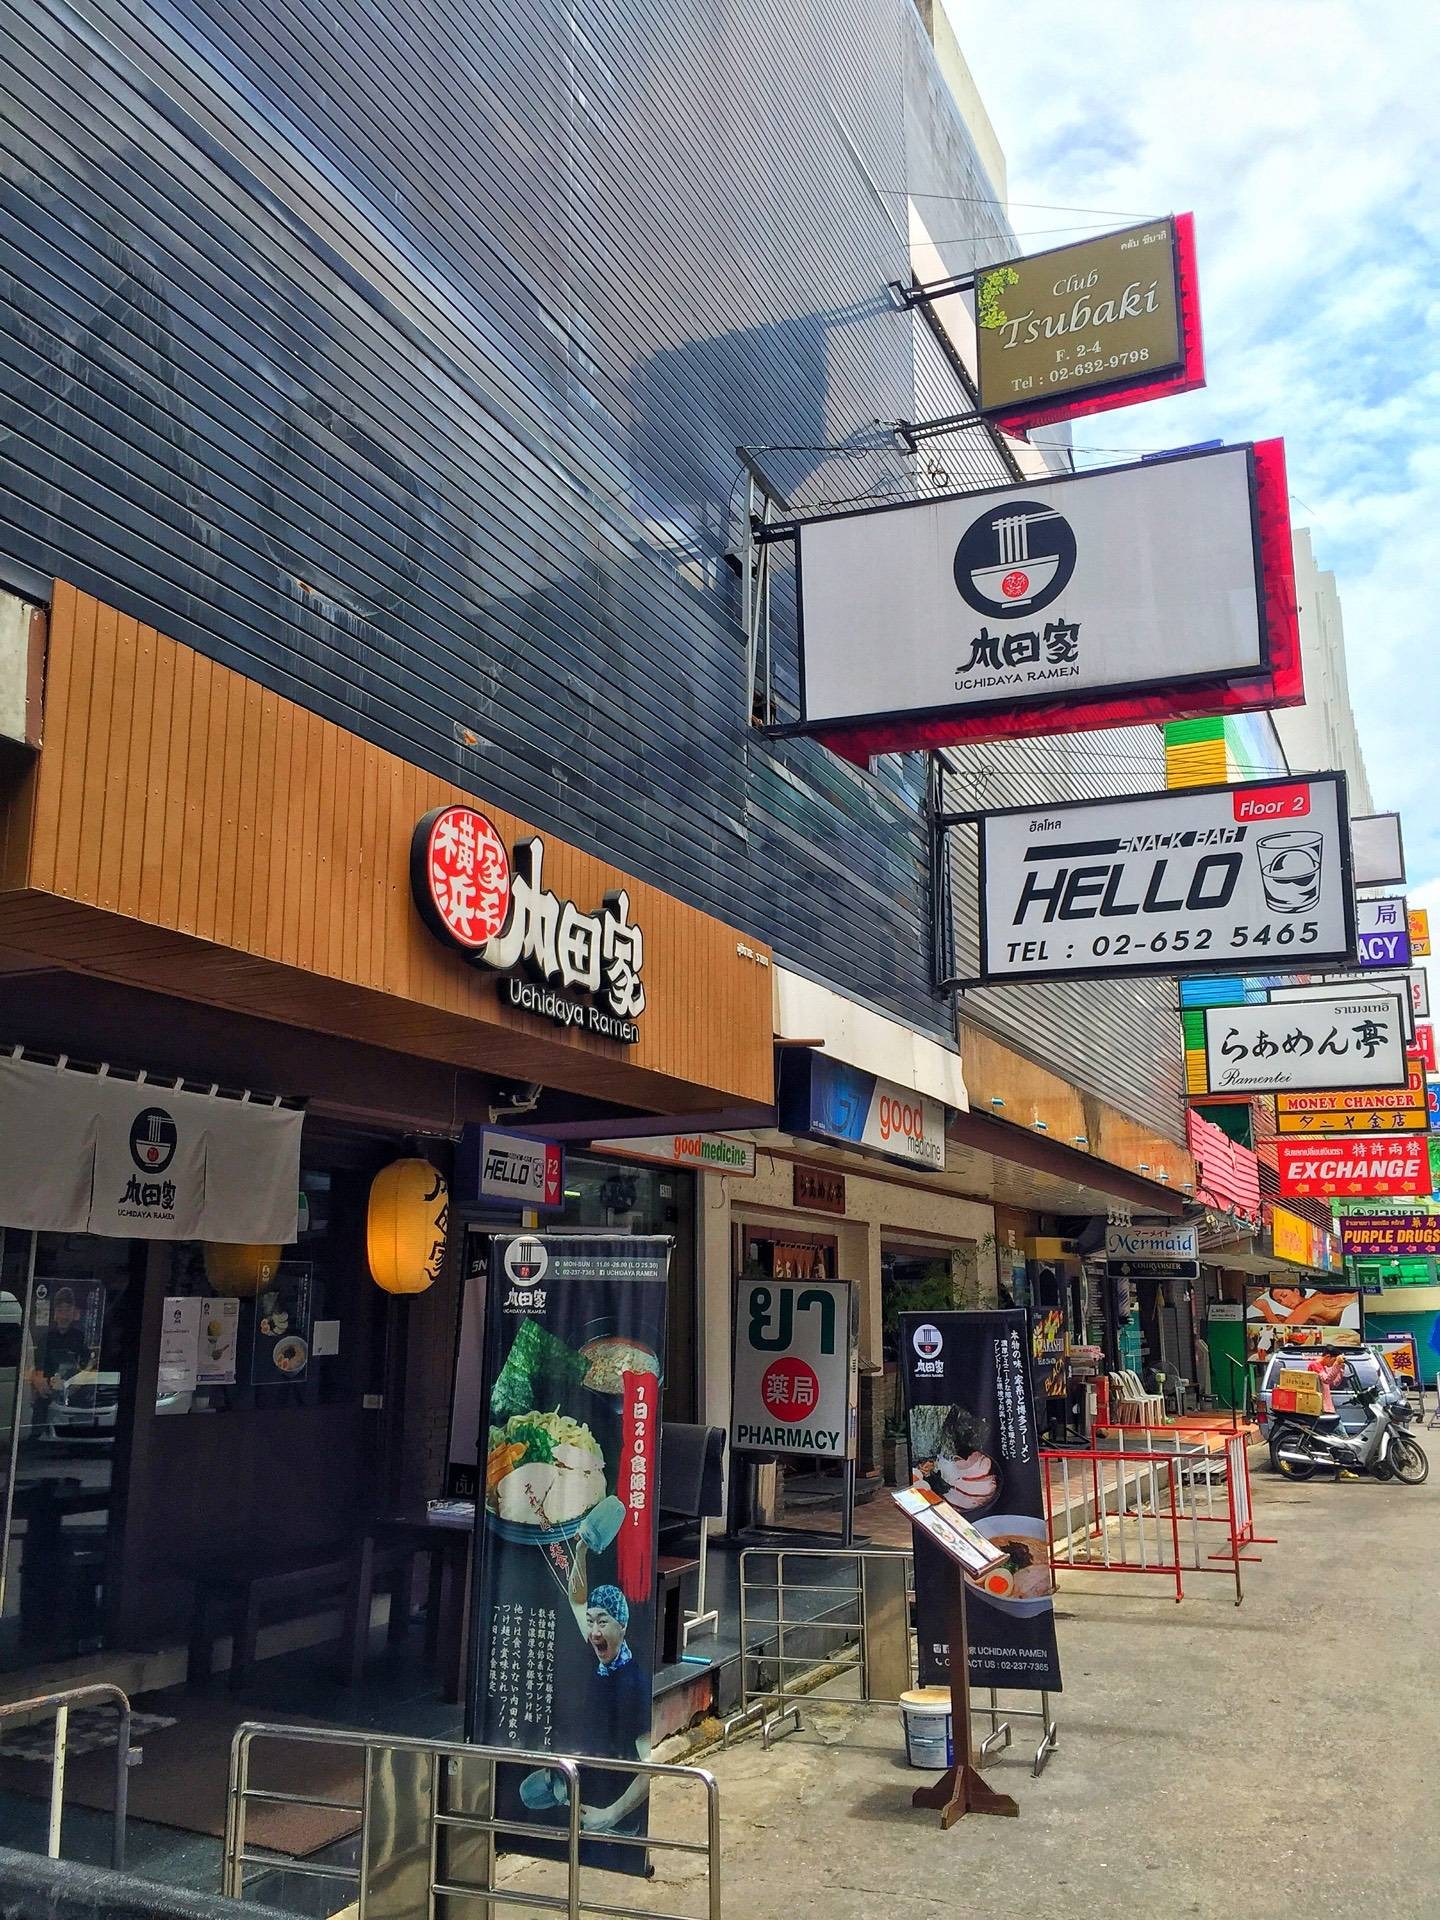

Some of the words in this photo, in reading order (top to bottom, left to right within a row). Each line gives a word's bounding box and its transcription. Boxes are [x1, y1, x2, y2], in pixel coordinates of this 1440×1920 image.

[1052, 268, 1099, 296] Club
[999, 280, 1160, 350] Tsubaki
[1055, 349, 1071, 363] F.
[1076, 341, 1102, 358] 2-4
[1011, 376, 1033, 391] Tel
[1050, 348, 1149, 383] 02-632-9798
[955, 673, 1024, 691] UCHIDAYA
[1027, 665, 1080, 682] RAMEN
[1240, 800, 1285, 817] Floor
[1292, 796, 1305, 812] 2
[1029, 818, 1062, 834] ฮัลโหล
[1117, 829, 1187, 853] SNACK
[1193, 827, 1238, 846] BAR
[1012, 851, 1243, 926] HELLO
[1007, 940, 1049, 963] TEL
[1092, 928, 1211, 957] 02-652
[1230, 921, 1319, 948] 5465
[509, 978, 583, 1026] Uchidaya
[589, 1006, 640, 1042] Ramen
[1221, 1019, 1389, 1063] らあめん亭
[1218, 1067, 1292, 1088] Ramentei
[1288, 1097, 1337, 1110] MONEY
[1344, 1095, 1416, 1108] CHANGER
[880, 1096, 924, 1140] good
[907, 1135, 941, 1160] medicine
[484, 1158, 530, 1184] HELLO
[547, 1159, 559, 1175] F2
[1287, 1159, 1421, 1180] EXCHANGE
[1109, 1233, 1193, 1254] Mermaid
[1344, 1230, 1394, 1244] PURPLE
[1397, 1229, 1440, 1243] DRUGS
[607, 1269, 634, 1277] UCHIDAYA
[636, 1269, 658, 1278] RAMEN
[748, 1286, 835, 1355] ยา
[766, 1374, 815, 1406] 薬局
[737, 1424, 840, 1451] PHARMACY
[977, 1646, 1018, 1657] UCHIDAYA
[1019, 1648, 1048, 1659] RAMEN
[984, 1660, 995, 1669] US
